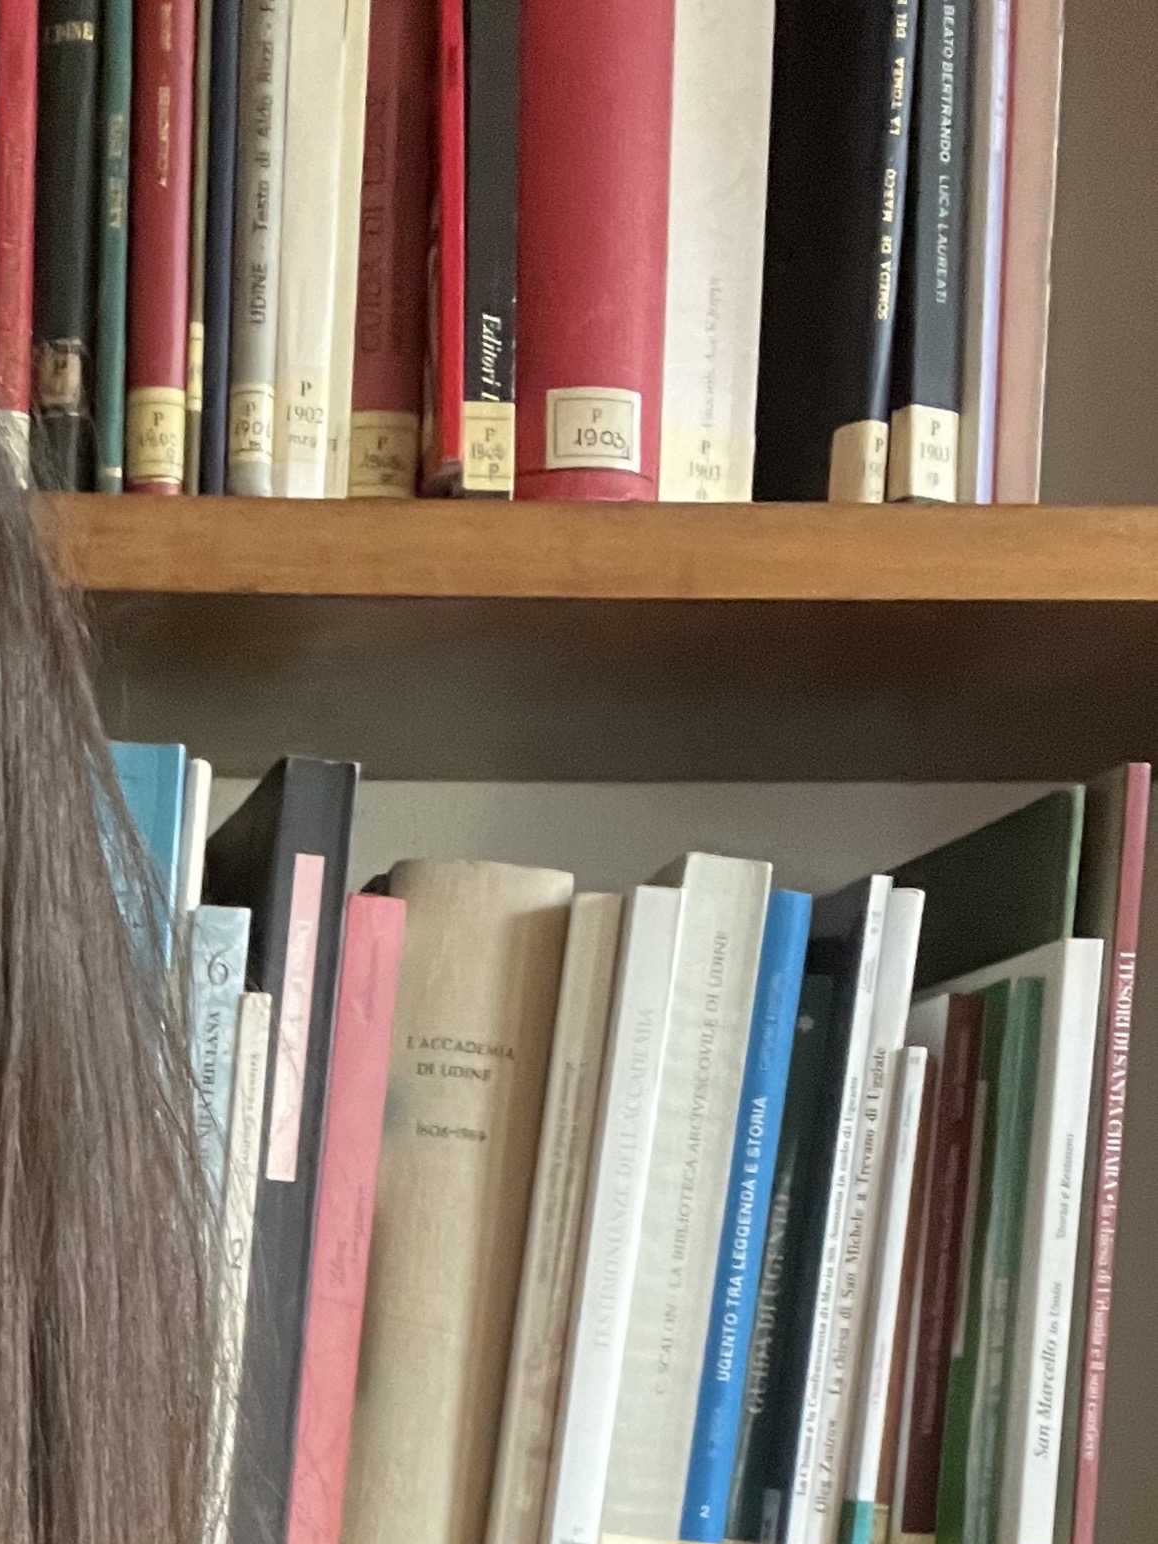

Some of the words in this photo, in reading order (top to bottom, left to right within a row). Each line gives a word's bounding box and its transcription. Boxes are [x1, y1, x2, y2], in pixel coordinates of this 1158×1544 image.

[888, 116, 903, 136] LA
[939, 61, 954, 163] BERTRANDO
[937, 174, 951, 218] LUCA
[479, 312, 503, 386] Editori
[286, 404, 324, 425] 1902
[300, 381, 312, 397] P
[592, 408, 604, 424] P
[485, 427, 496, 443] P
[1115, 961, 1137, 1029] TESORI
[1113, 1031, 1131, 1052] DI
[1108, 1053, 1128, 1117] SANTA
[672, 1158, 699, 1261] BIBLIOTECA
[687, 1017, 719, 1154] ARCIVESCOVILE
[747, 1096, 769, 1158] STORIA
[1103, 1118, 1124, 1191] CHIARA
[854, 1129, 876, 1184] Trevano
[730, 1179, 757, 1270] LEGGENDA
[844, 1208, 865, 1265] Michele
[725, 1275, 743, 1308] TRA
[839, 1272, 857, 1299] San
[716, 1312, 741, 1382] UGENTO
[1036, 1339, 1058, 1420] Marcello
[1033, 1424, 1051, 1459] San
